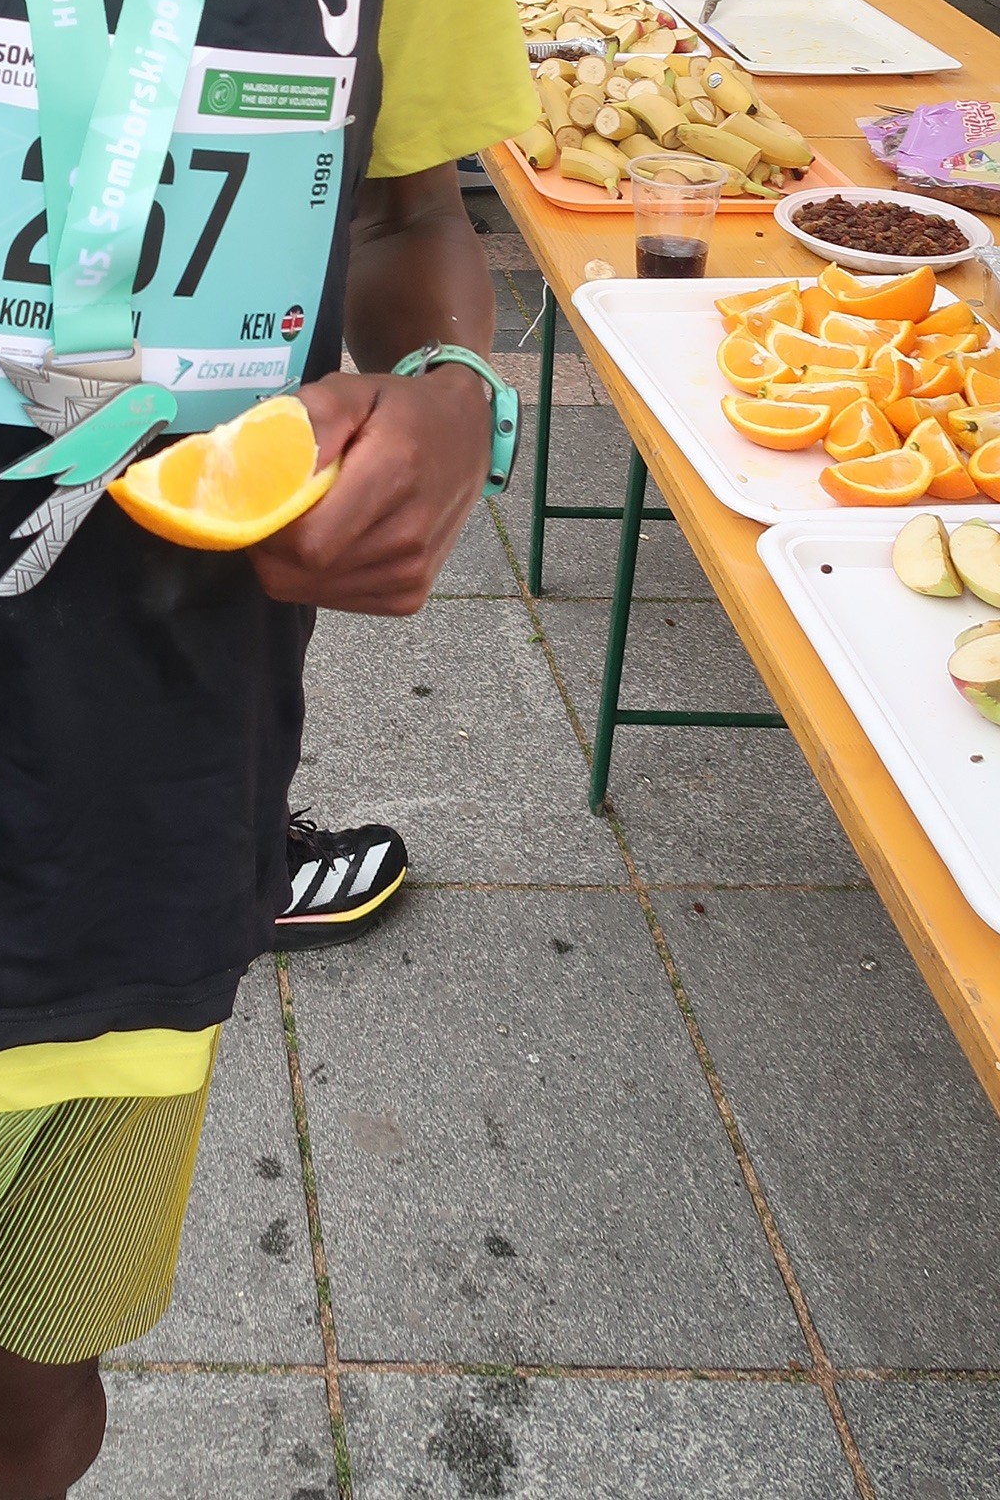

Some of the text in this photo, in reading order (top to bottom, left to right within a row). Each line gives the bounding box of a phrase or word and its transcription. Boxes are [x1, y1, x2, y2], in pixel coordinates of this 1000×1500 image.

[89, 46, 167, 231] Somborski
[309, 153, 334, 209] 1998
[239, 313, 277, 341] KEN
[238, 360, 286, 379] LEPOTA
